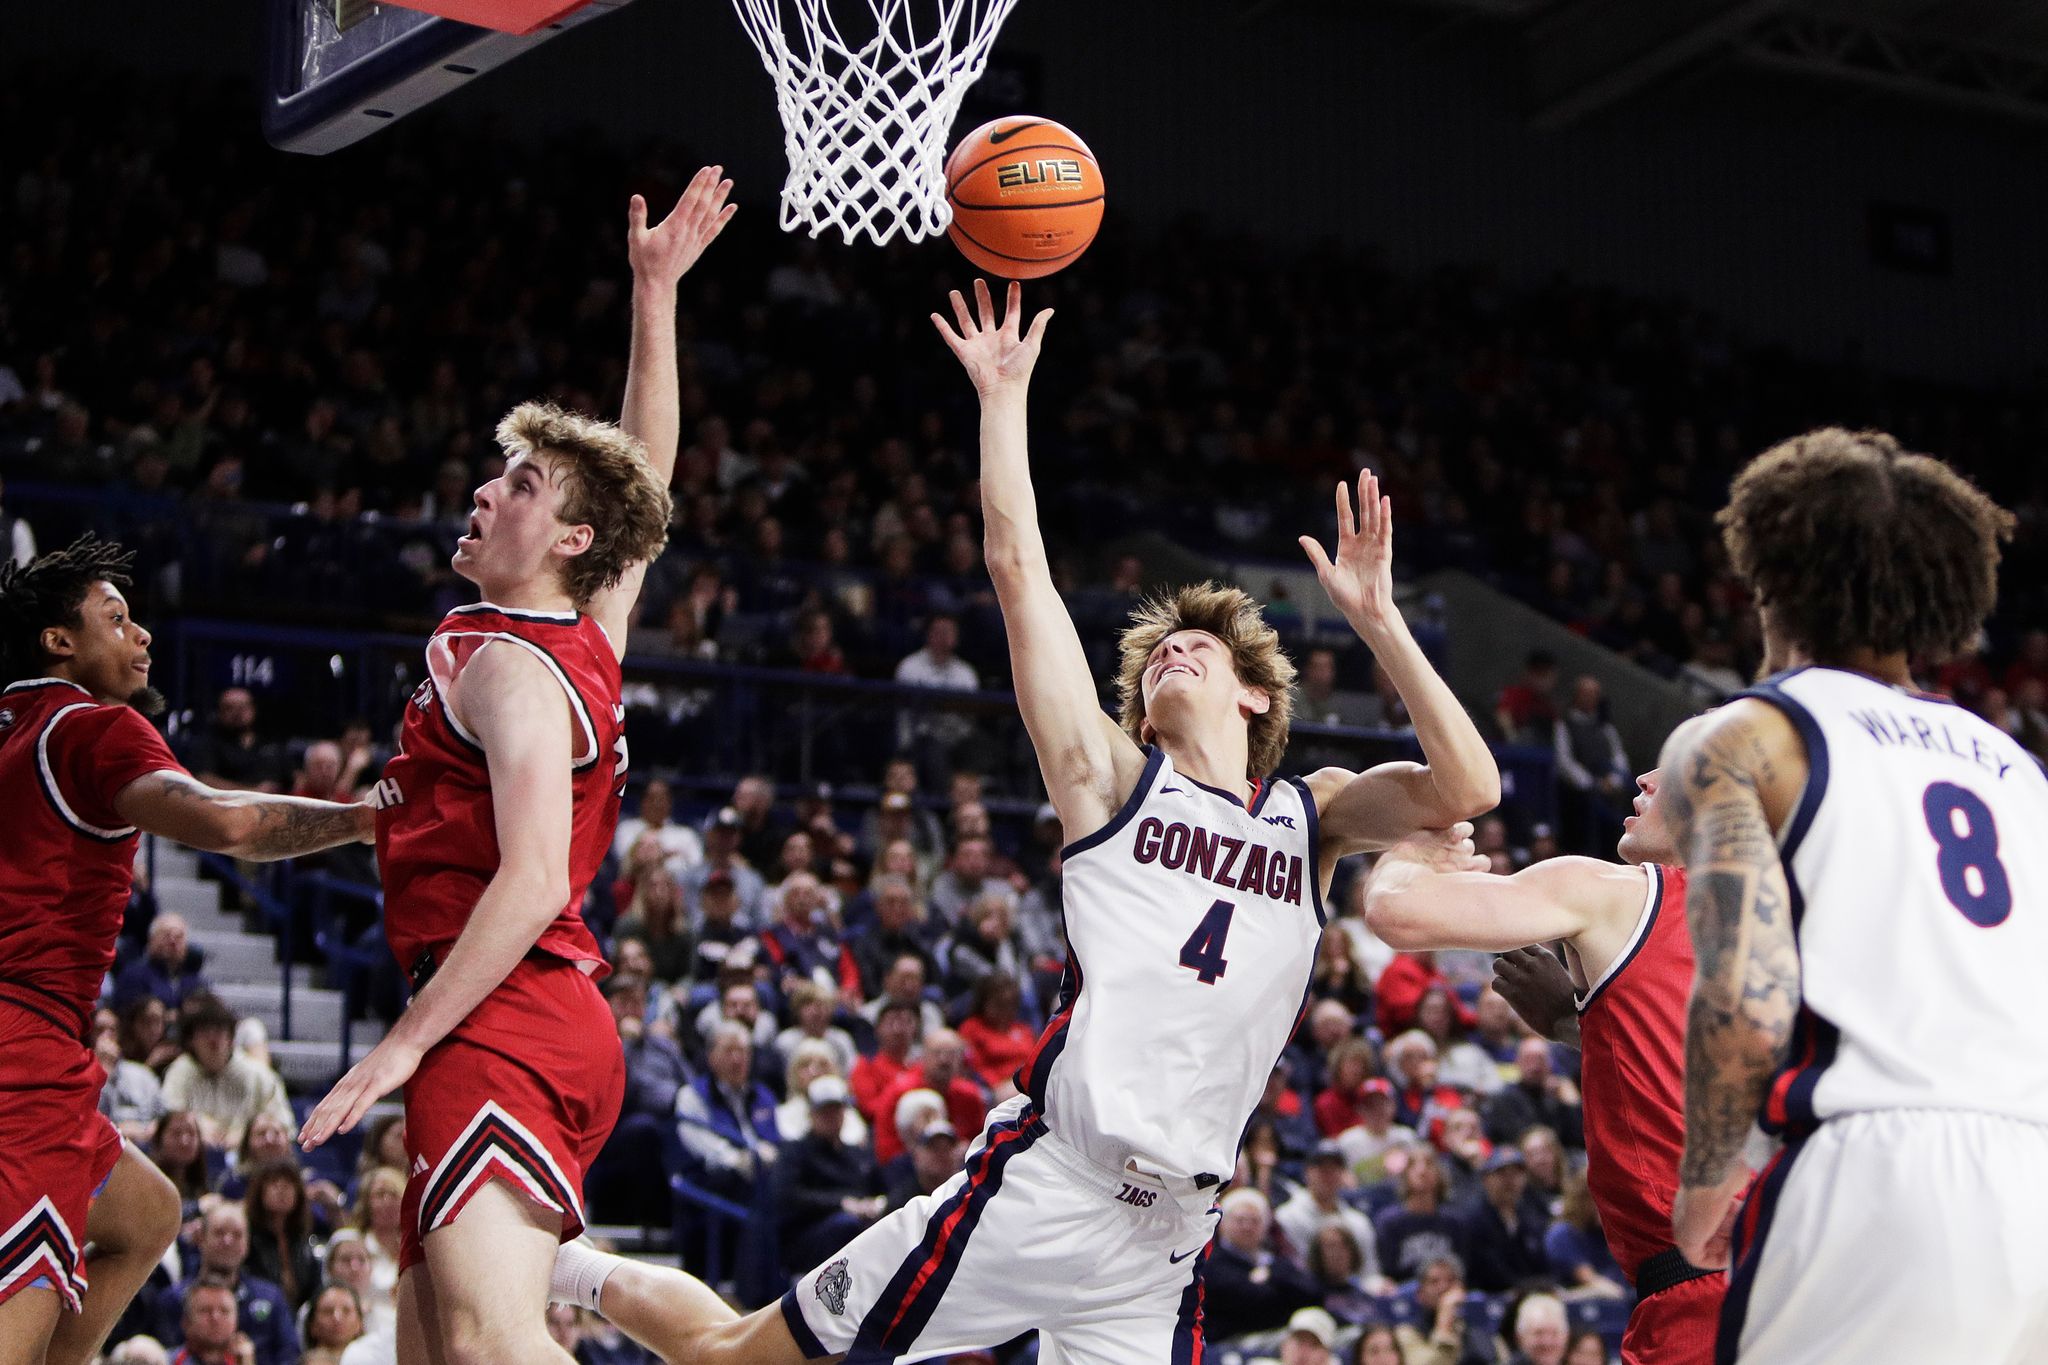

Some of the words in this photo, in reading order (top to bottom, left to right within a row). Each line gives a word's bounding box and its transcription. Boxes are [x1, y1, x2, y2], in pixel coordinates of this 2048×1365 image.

[997, 159, 1082, 189] ELITE
[231, 653, 274, 687] 114
[1849, 709, 2010, 779] WARLEY
[1133, 816, 1303, 907] GONZAGA
[1922, 780, 2013, 928] 8
[1178, 898, 1236, 986] 4
[1115, 1183, 1157, 1208] ZAGS
